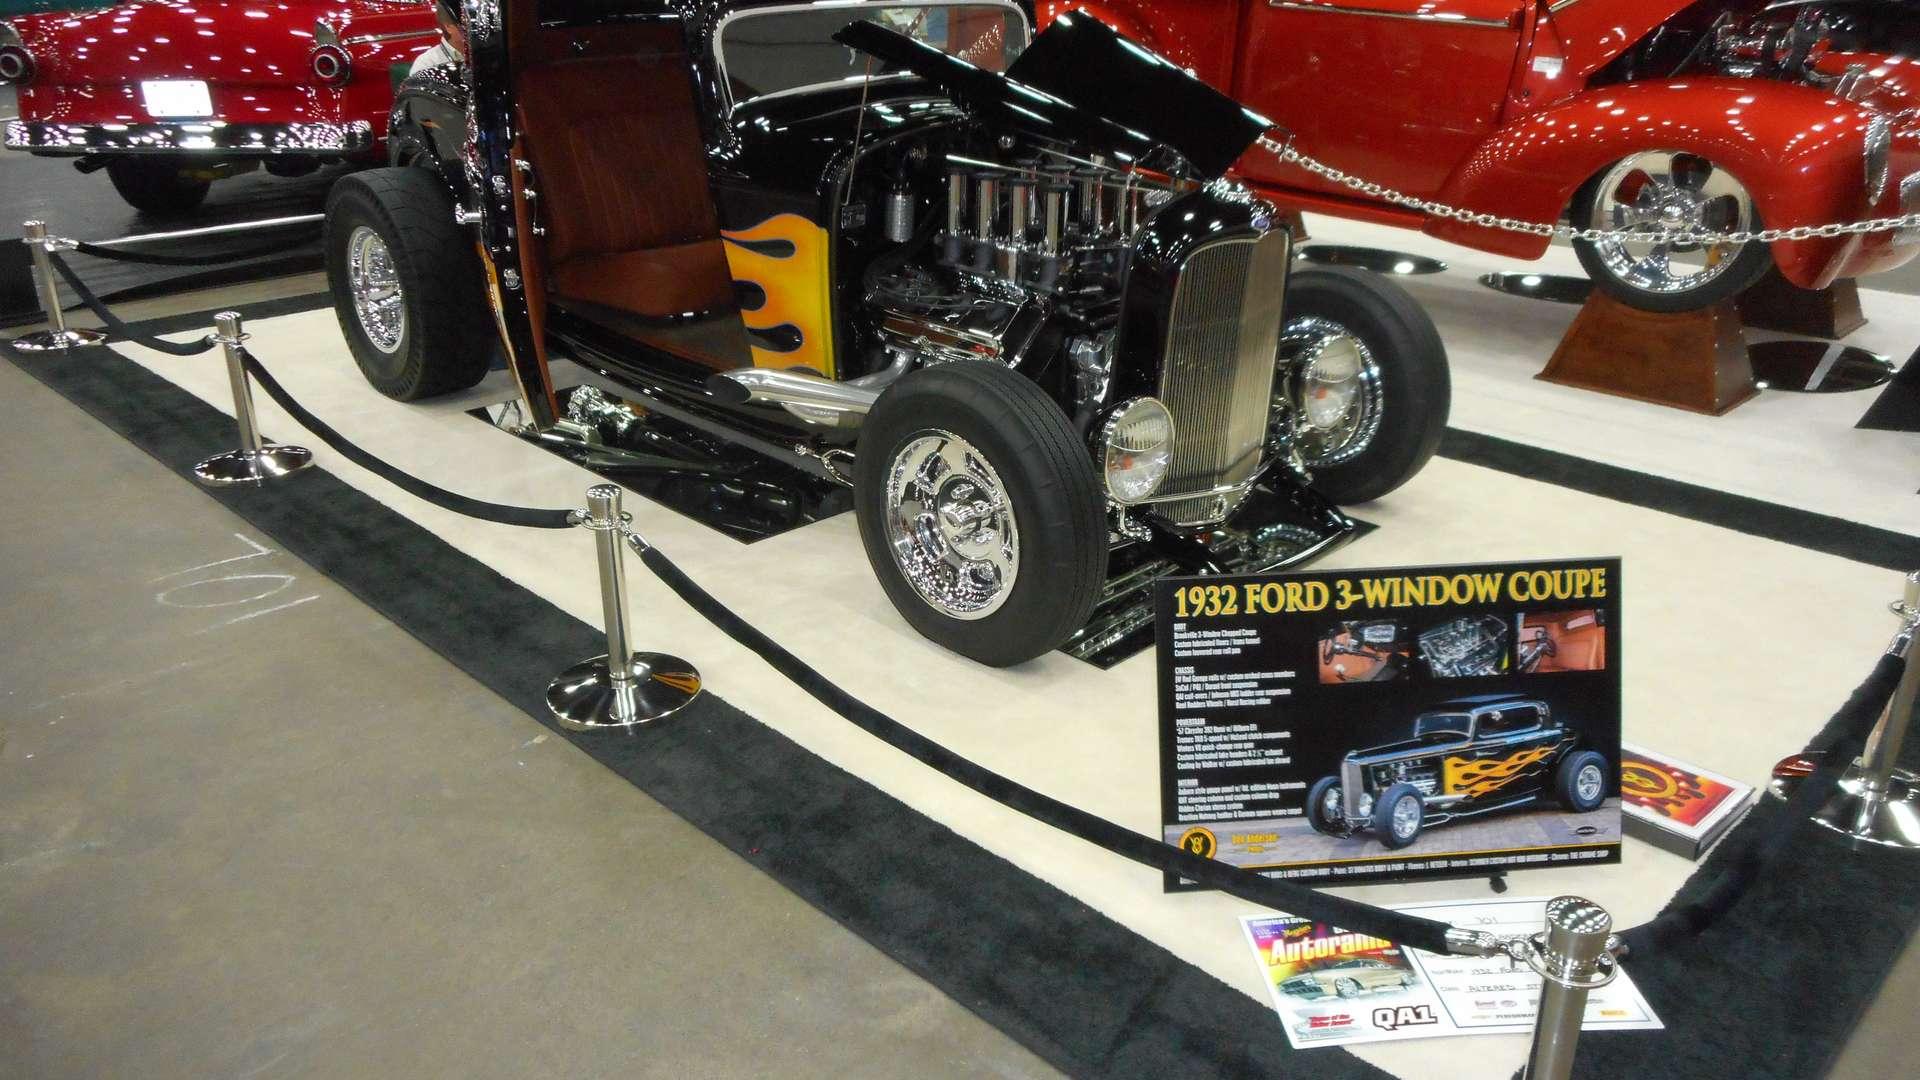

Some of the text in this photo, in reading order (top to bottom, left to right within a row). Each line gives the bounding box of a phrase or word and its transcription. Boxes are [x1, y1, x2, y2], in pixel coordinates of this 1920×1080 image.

[1174, 568, 1606, 617] 1932 FORD 3-WINDOW COUPE
[1373, 1005, 1438, 1031] QA1
